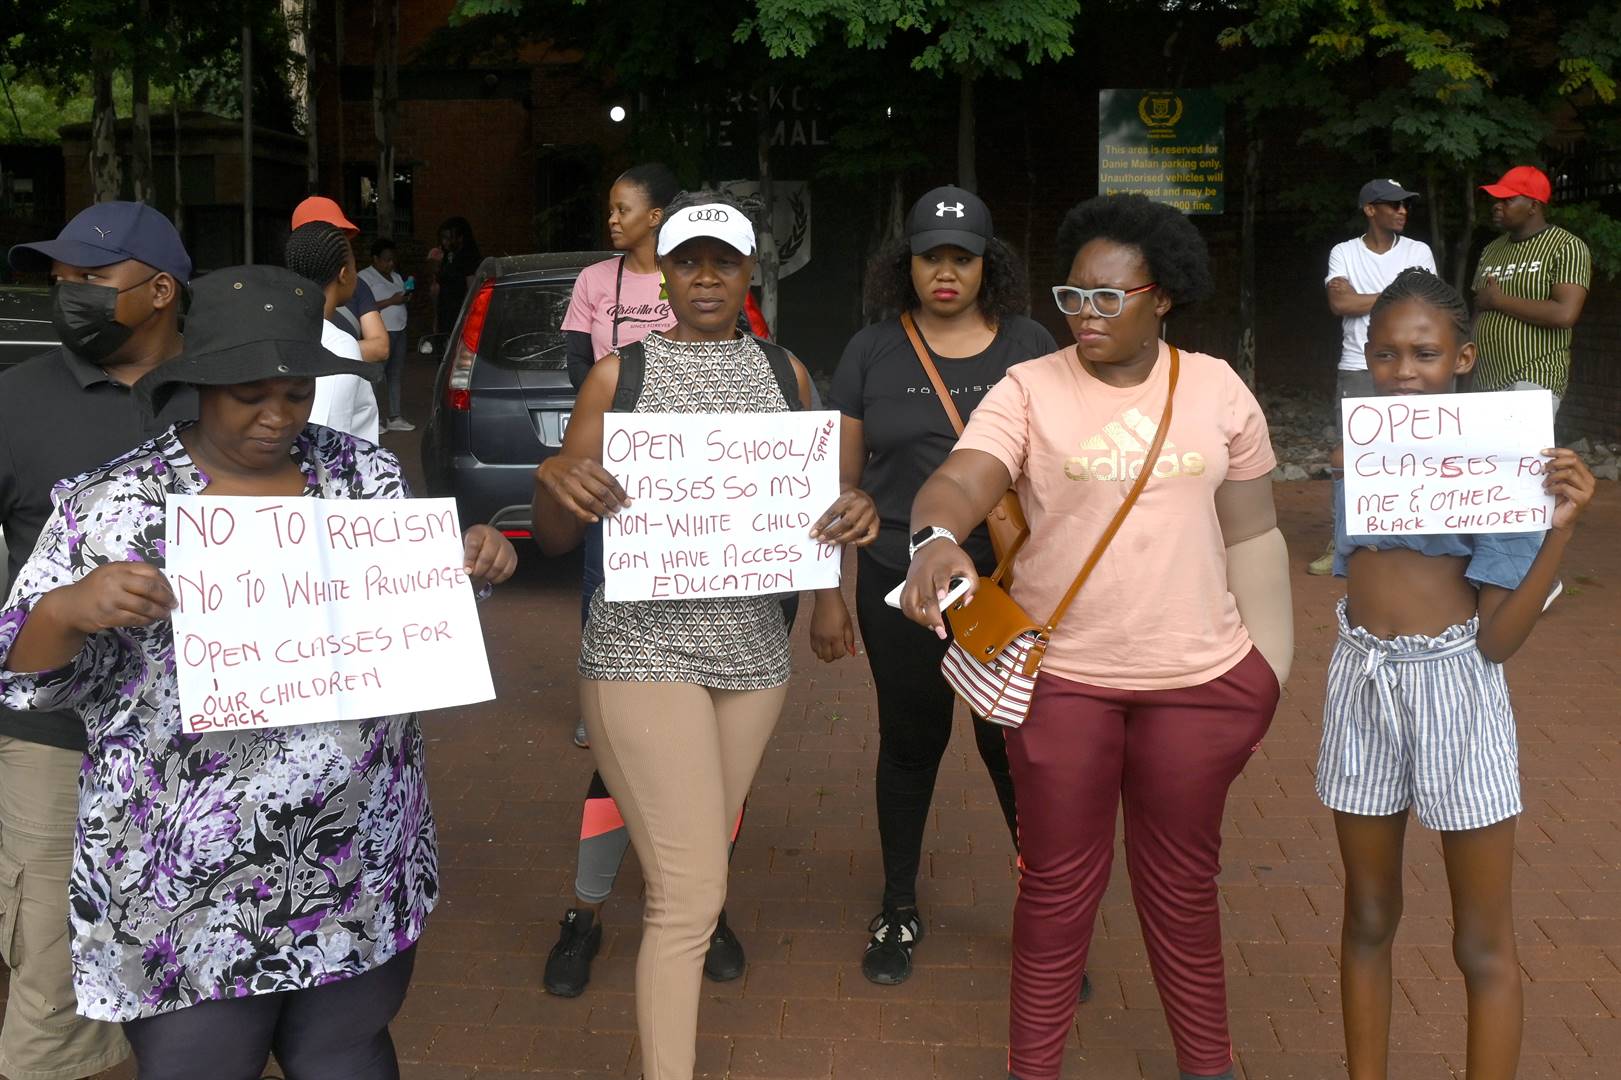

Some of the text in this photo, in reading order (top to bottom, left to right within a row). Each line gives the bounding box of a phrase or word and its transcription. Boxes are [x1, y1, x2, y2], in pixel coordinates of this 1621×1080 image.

[1105, 145, 1125, 154] This
[1151, 145, 1159, 154] is
[1161, 145, 1203, 154] reserved
[1205, 145, 1218, 154] for
[1100, 173, 1223, 182] Unauthorised vehicles will
[1102, 160, 1222, 171] Danie Malan parking only.
[1163, 188, 1180, 197] and
[1183, 189, 1202, 199] may
[1205, 188, 1217, 197] be
[606, 304, 652, 317] Priscilla
[1348, 403, 1462, 446] OPEN
[607, 429, 684, 462] OPEN
[813, 419, 835, 463] SPARE
[1355, 452, 1546, 479] CLASSES FO
[613, 474, 715, 503] LASSES
[1357, 484, 1511, 515] ME & OTHER
[176, 506, 235, 549] NO
[256, 505, 306, 549] TO
[608, 511, 811, 538] NON-WHITE CHILD
[1367, 505, 1547, 533] BLACK CHILDREN
[608, 542, 836, 573] CAN HAVE ACCESS TO
[178, 565, 466, 614] NO TO WHITE PRIVILAGE
[651, 569, 794, 598] EDUCATION
[184, 620, 453, 673] OPEN CLASSES FOR
[203, 667, 382, 716] OUR CHILDREN
[189, 709, 269, 732] BLACK
